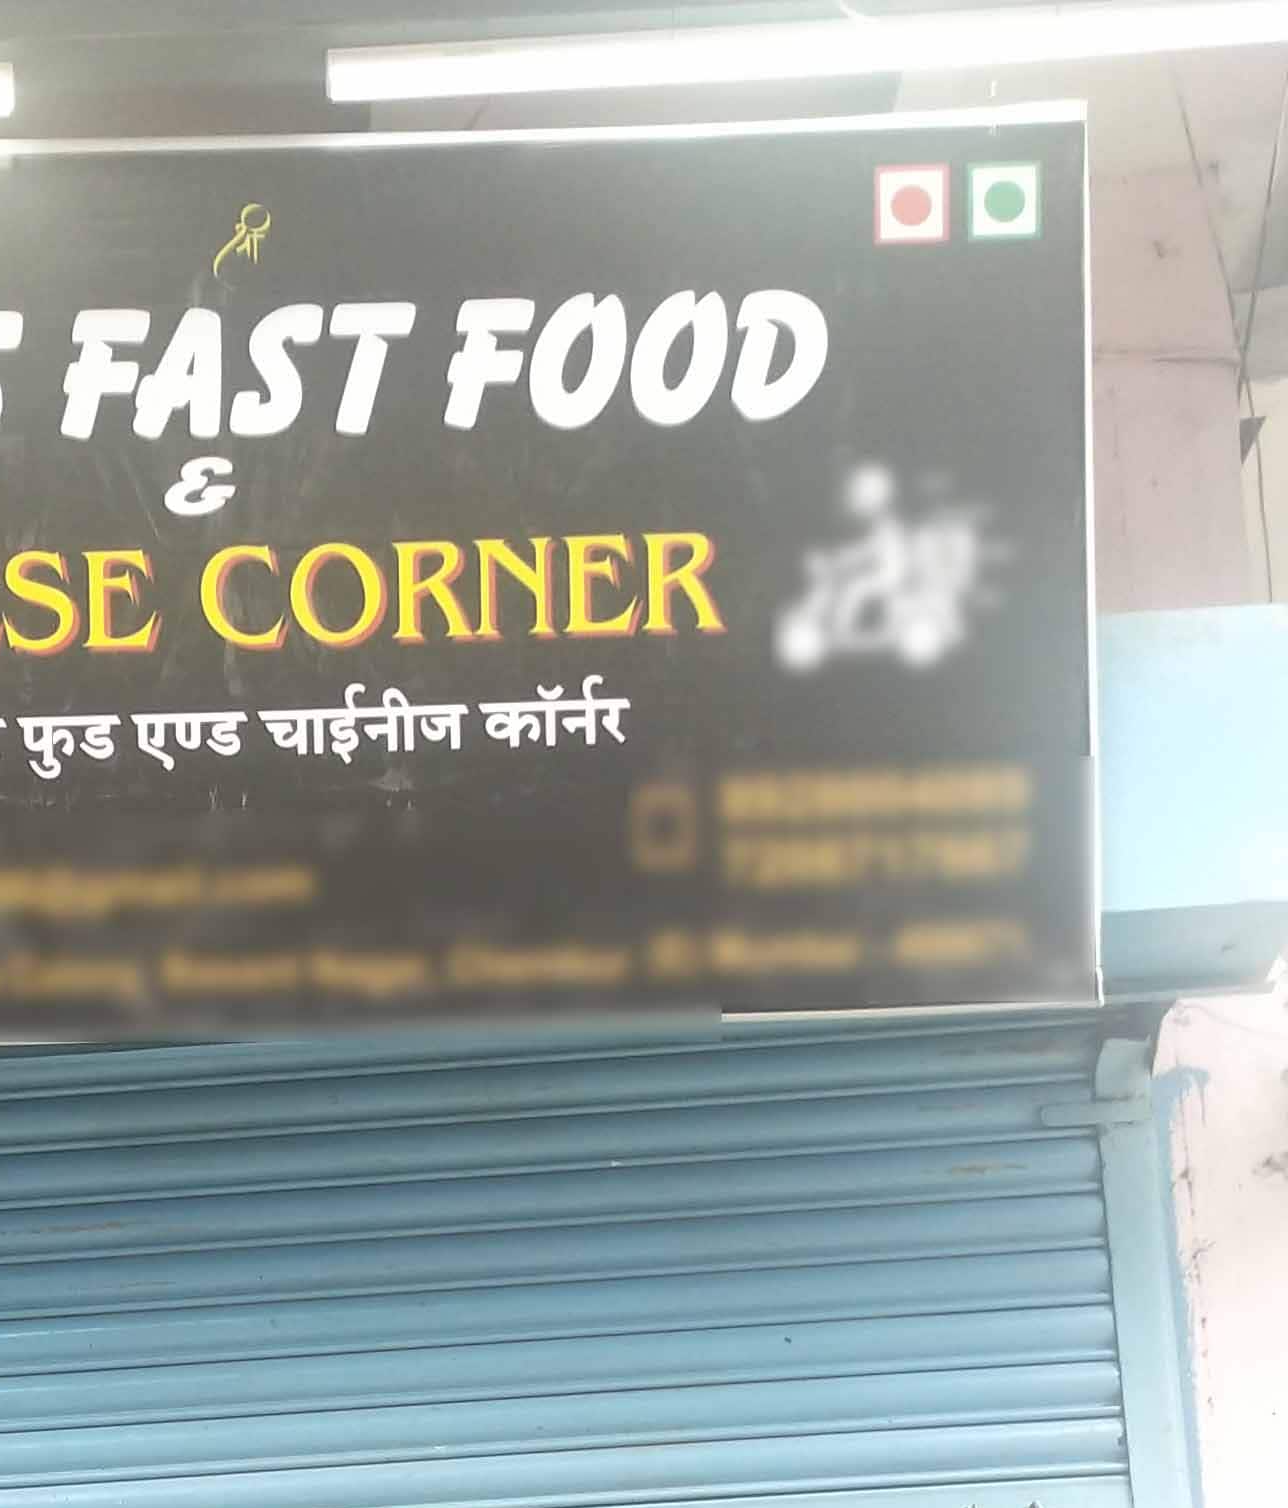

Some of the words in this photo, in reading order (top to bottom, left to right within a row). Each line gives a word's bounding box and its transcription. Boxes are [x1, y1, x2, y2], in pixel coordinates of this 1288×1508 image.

[60, 302, 417, 439] FAST
[444, 289, 829, 429] FOOD
[164, 456, 235, 516] &
[200, 531, 728, 650] CORNER
[20, 714, 120, 779] फुड
[131, 711, 248, 770] एण्ड
[257, 682, 469, 765] चाईनीज
[479, 675, 630, 751] कॉर्नर
